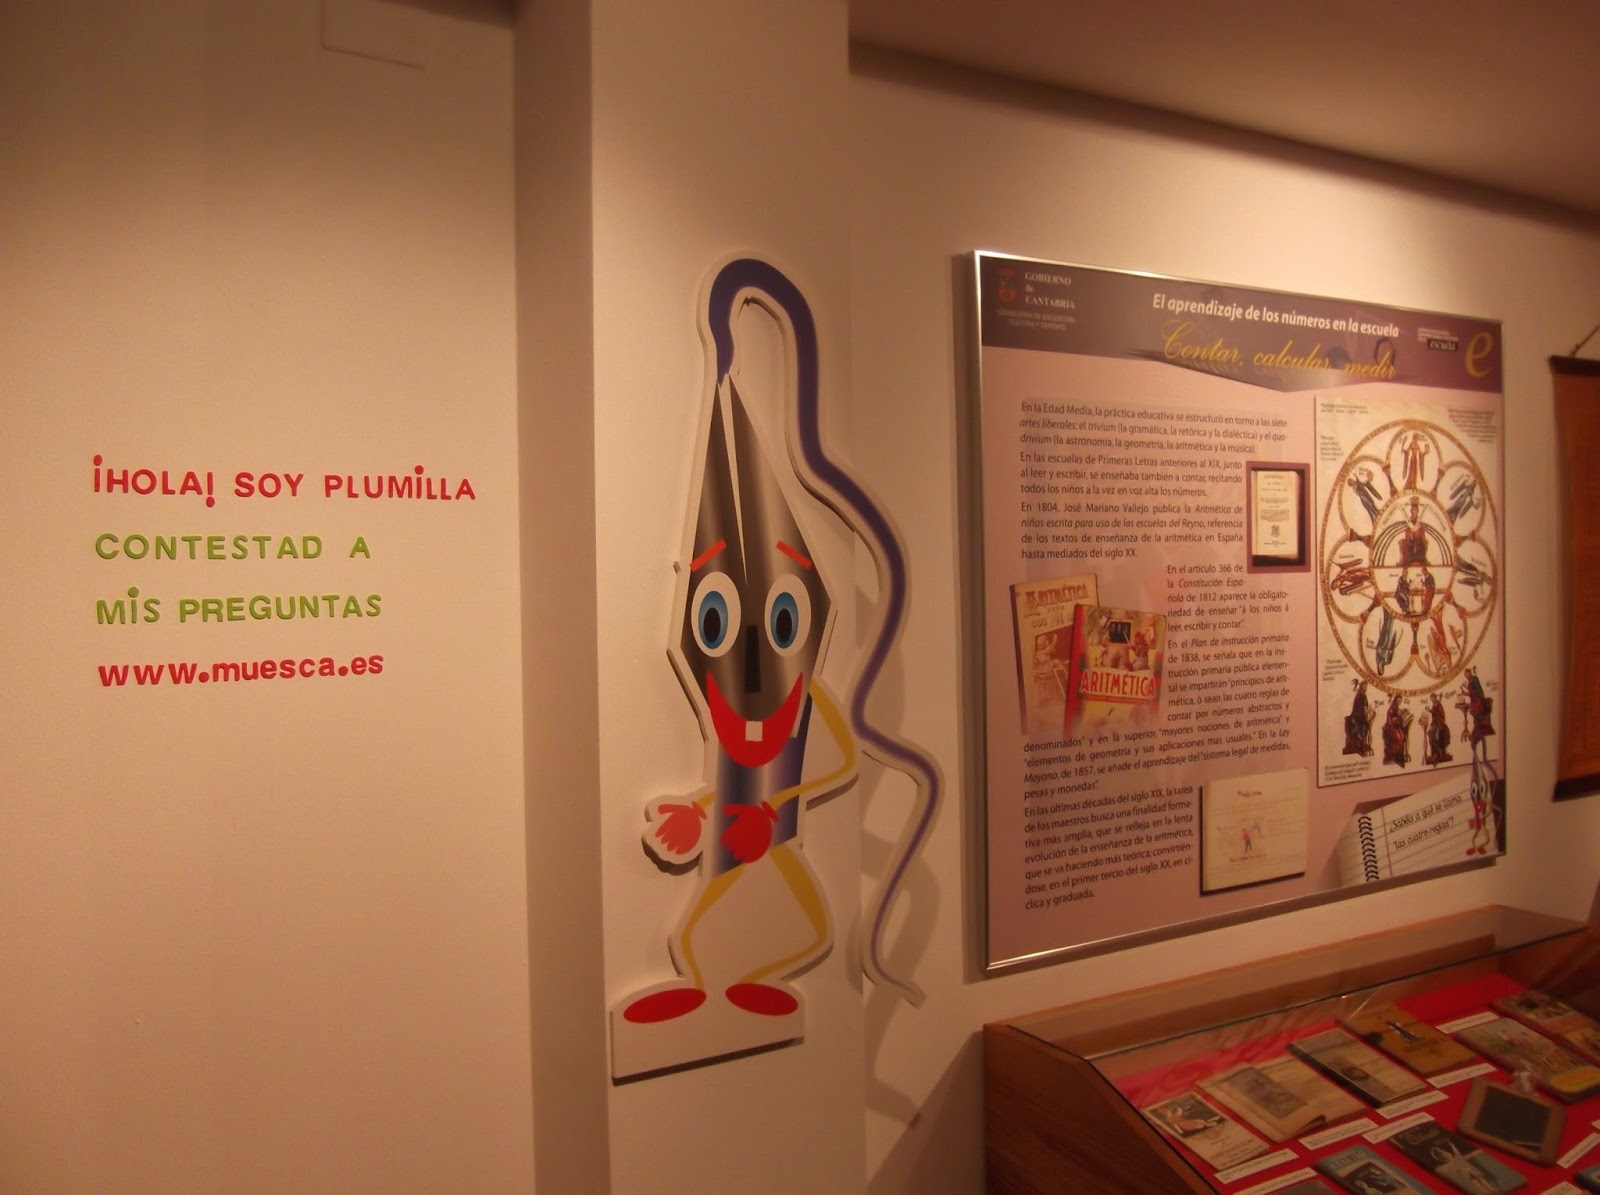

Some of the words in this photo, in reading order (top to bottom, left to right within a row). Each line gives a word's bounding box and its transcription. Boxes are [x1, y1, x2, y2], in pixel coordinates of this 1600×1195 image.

[1025, 272, 1072, 286] GOBIERNO
[1025, 296, 1076, 310] CANTABRIA
[1153, 293, 1164, 309] El
[1168, 297, 1243, 322] aprendizaje
[1245, 304, 1260, 320] de
[1262, 306, 1279, 323] los
[1282, 310, 1330, 330] números
[1333, 319, 1346, 331] en
[1349, 317, 1358, 333] la
[1360, 320, 1399, 337] escuela
[1034, 452, 1045, 462] las
[1047, 453, 1082, 463] escuelas
[1098, 454, 1133, 465] Primeras
[1134, 456, 1158, 466] Letras
[1160, 458, 1198, 468] anteriores
[1223, 460, 1242, 472] junto
[234, 472, 304, 498] SOY
[1020, 484, 1046, 493] todos
[1047, 484, 1060, 494] los
[1061, 484, 1084, 494] niños
[1101, 487, 1115, 495] vez
[1144, 486, 1159, 495] alta
[1160, 486, 1172, 495] los
[95, 532, 323, 560] CONTESTAD
[349, 536, 371, 559] A
[1036, 533, 1048, 543] los
[1052, 534, 1078, 543] textos
[1095, 533, 1138, 542] enseñanza
[1164, 532, 1202, 542] aritmética
[1218, 532, 1243, 545] España
[1022, 549, 1044, 558] hasta
[1046, 548, 1088, 558] mediados
[1090, 547, 1103, 557] del
[1104, 547, 1123, 560] siglo
[1218, 563, 1232, 573] 366
[179, 593, 383, 623] PREGUNTAS
[98, 654, 385, 687] www.muesca.es
[1080, 669, 1157, 698] ARITMÉTICA
[1037, 821, 1050, 831] los
[1051, 816, 1089, 828] maestros
[1090, 812, 1115, 822] busca
[1116, 809, 1132, 818] una
[1132, 801, 1166, 815] finalidad
[1168, 800, 1193, 810] forma-
